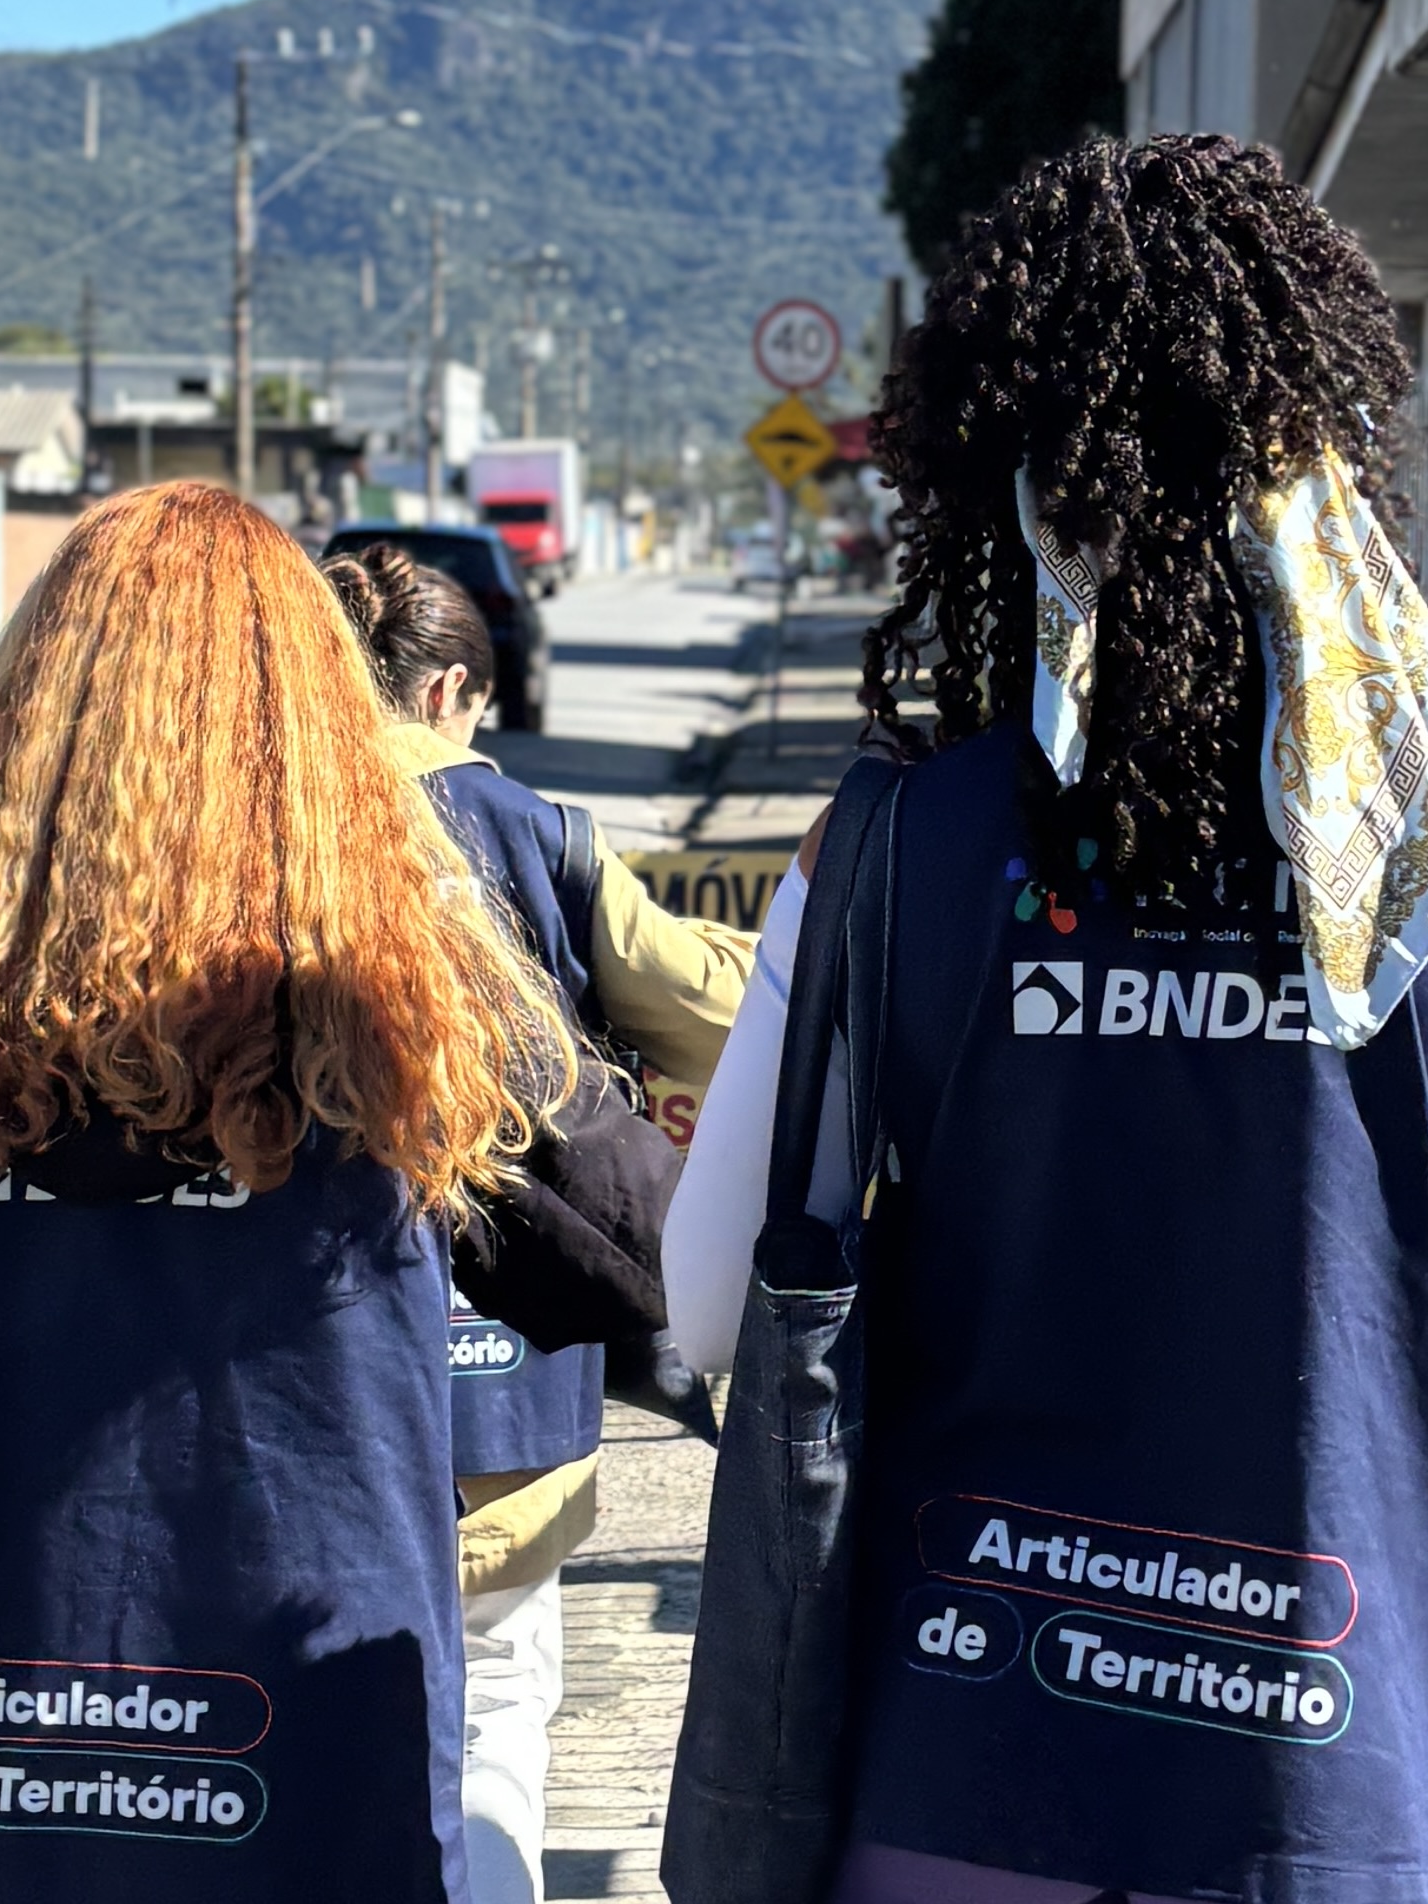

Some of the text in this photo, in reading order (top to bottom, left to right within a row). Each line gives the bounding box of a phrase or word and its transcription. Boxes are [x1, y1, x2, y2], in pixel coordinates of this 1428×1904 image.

[771, 320, 827, 360] 40
[1098, 969, 1309, 1042] BNDE
[968, 1518, 1302, 1622] Articulador
[917, 1607, 1336, 1727] de Território
